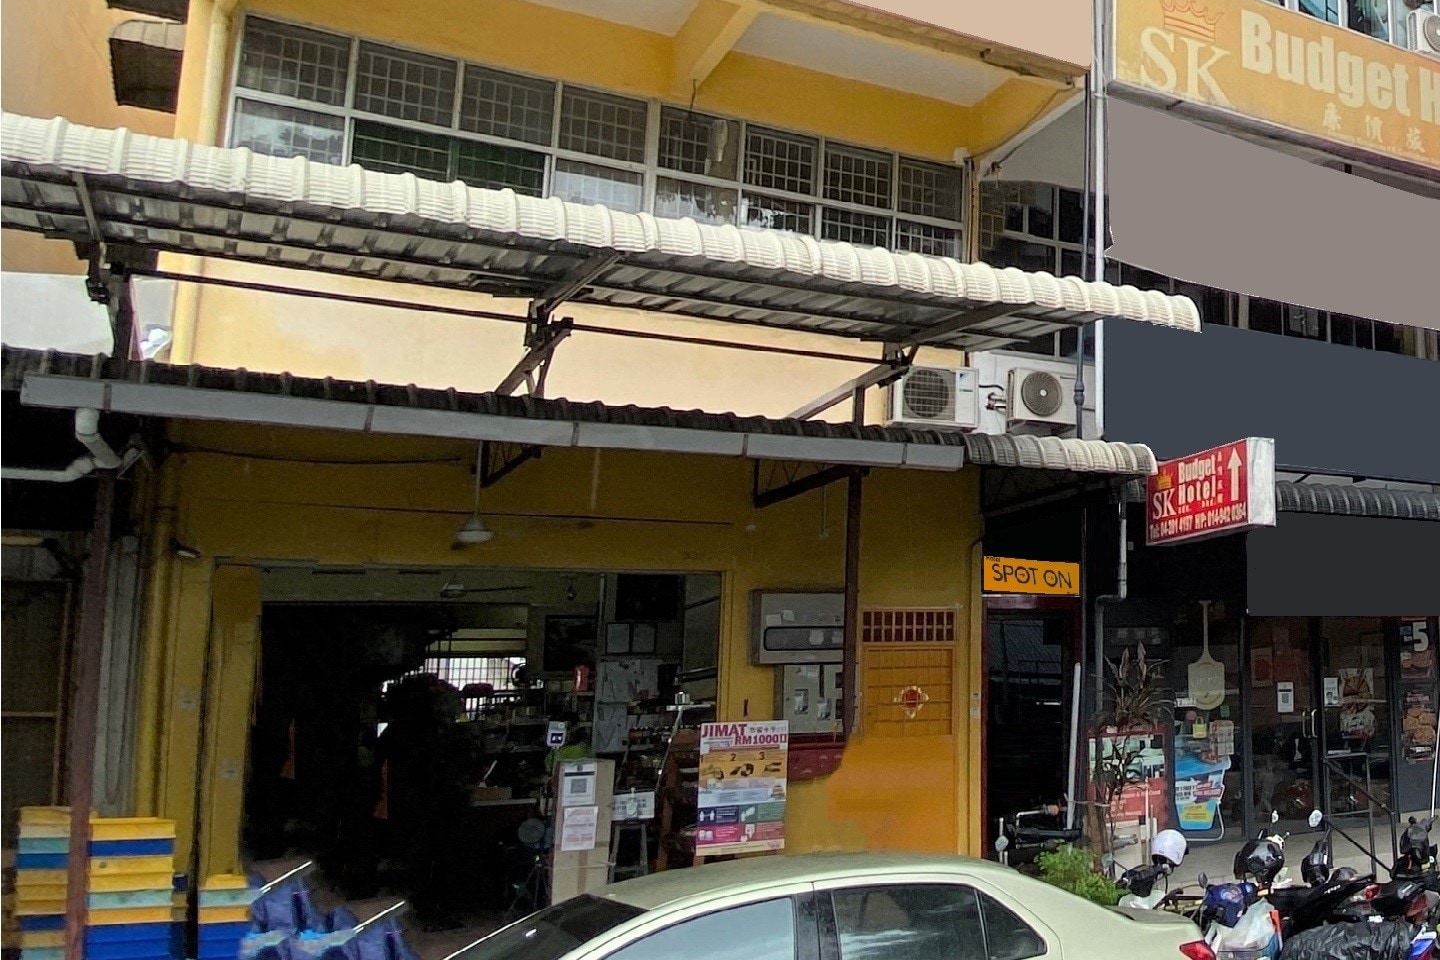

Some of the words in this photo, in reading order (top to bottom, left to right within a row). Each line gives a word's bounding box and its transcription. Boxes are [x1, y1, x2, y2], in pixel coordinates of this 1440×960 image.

[1140, 27, 1236, 108] SK
[1241, 9, 1411, 117] Budget
[1178, 454, 1216, 483] Budget
[1153, 488, 1177, 519] SK
[1178, 474, 1217, 506] Hotel
[991, 563, 1038, 585] SPOT
[1043, 569, 1072, 589] ON
[702, 724, 747, 738] JIMAT
